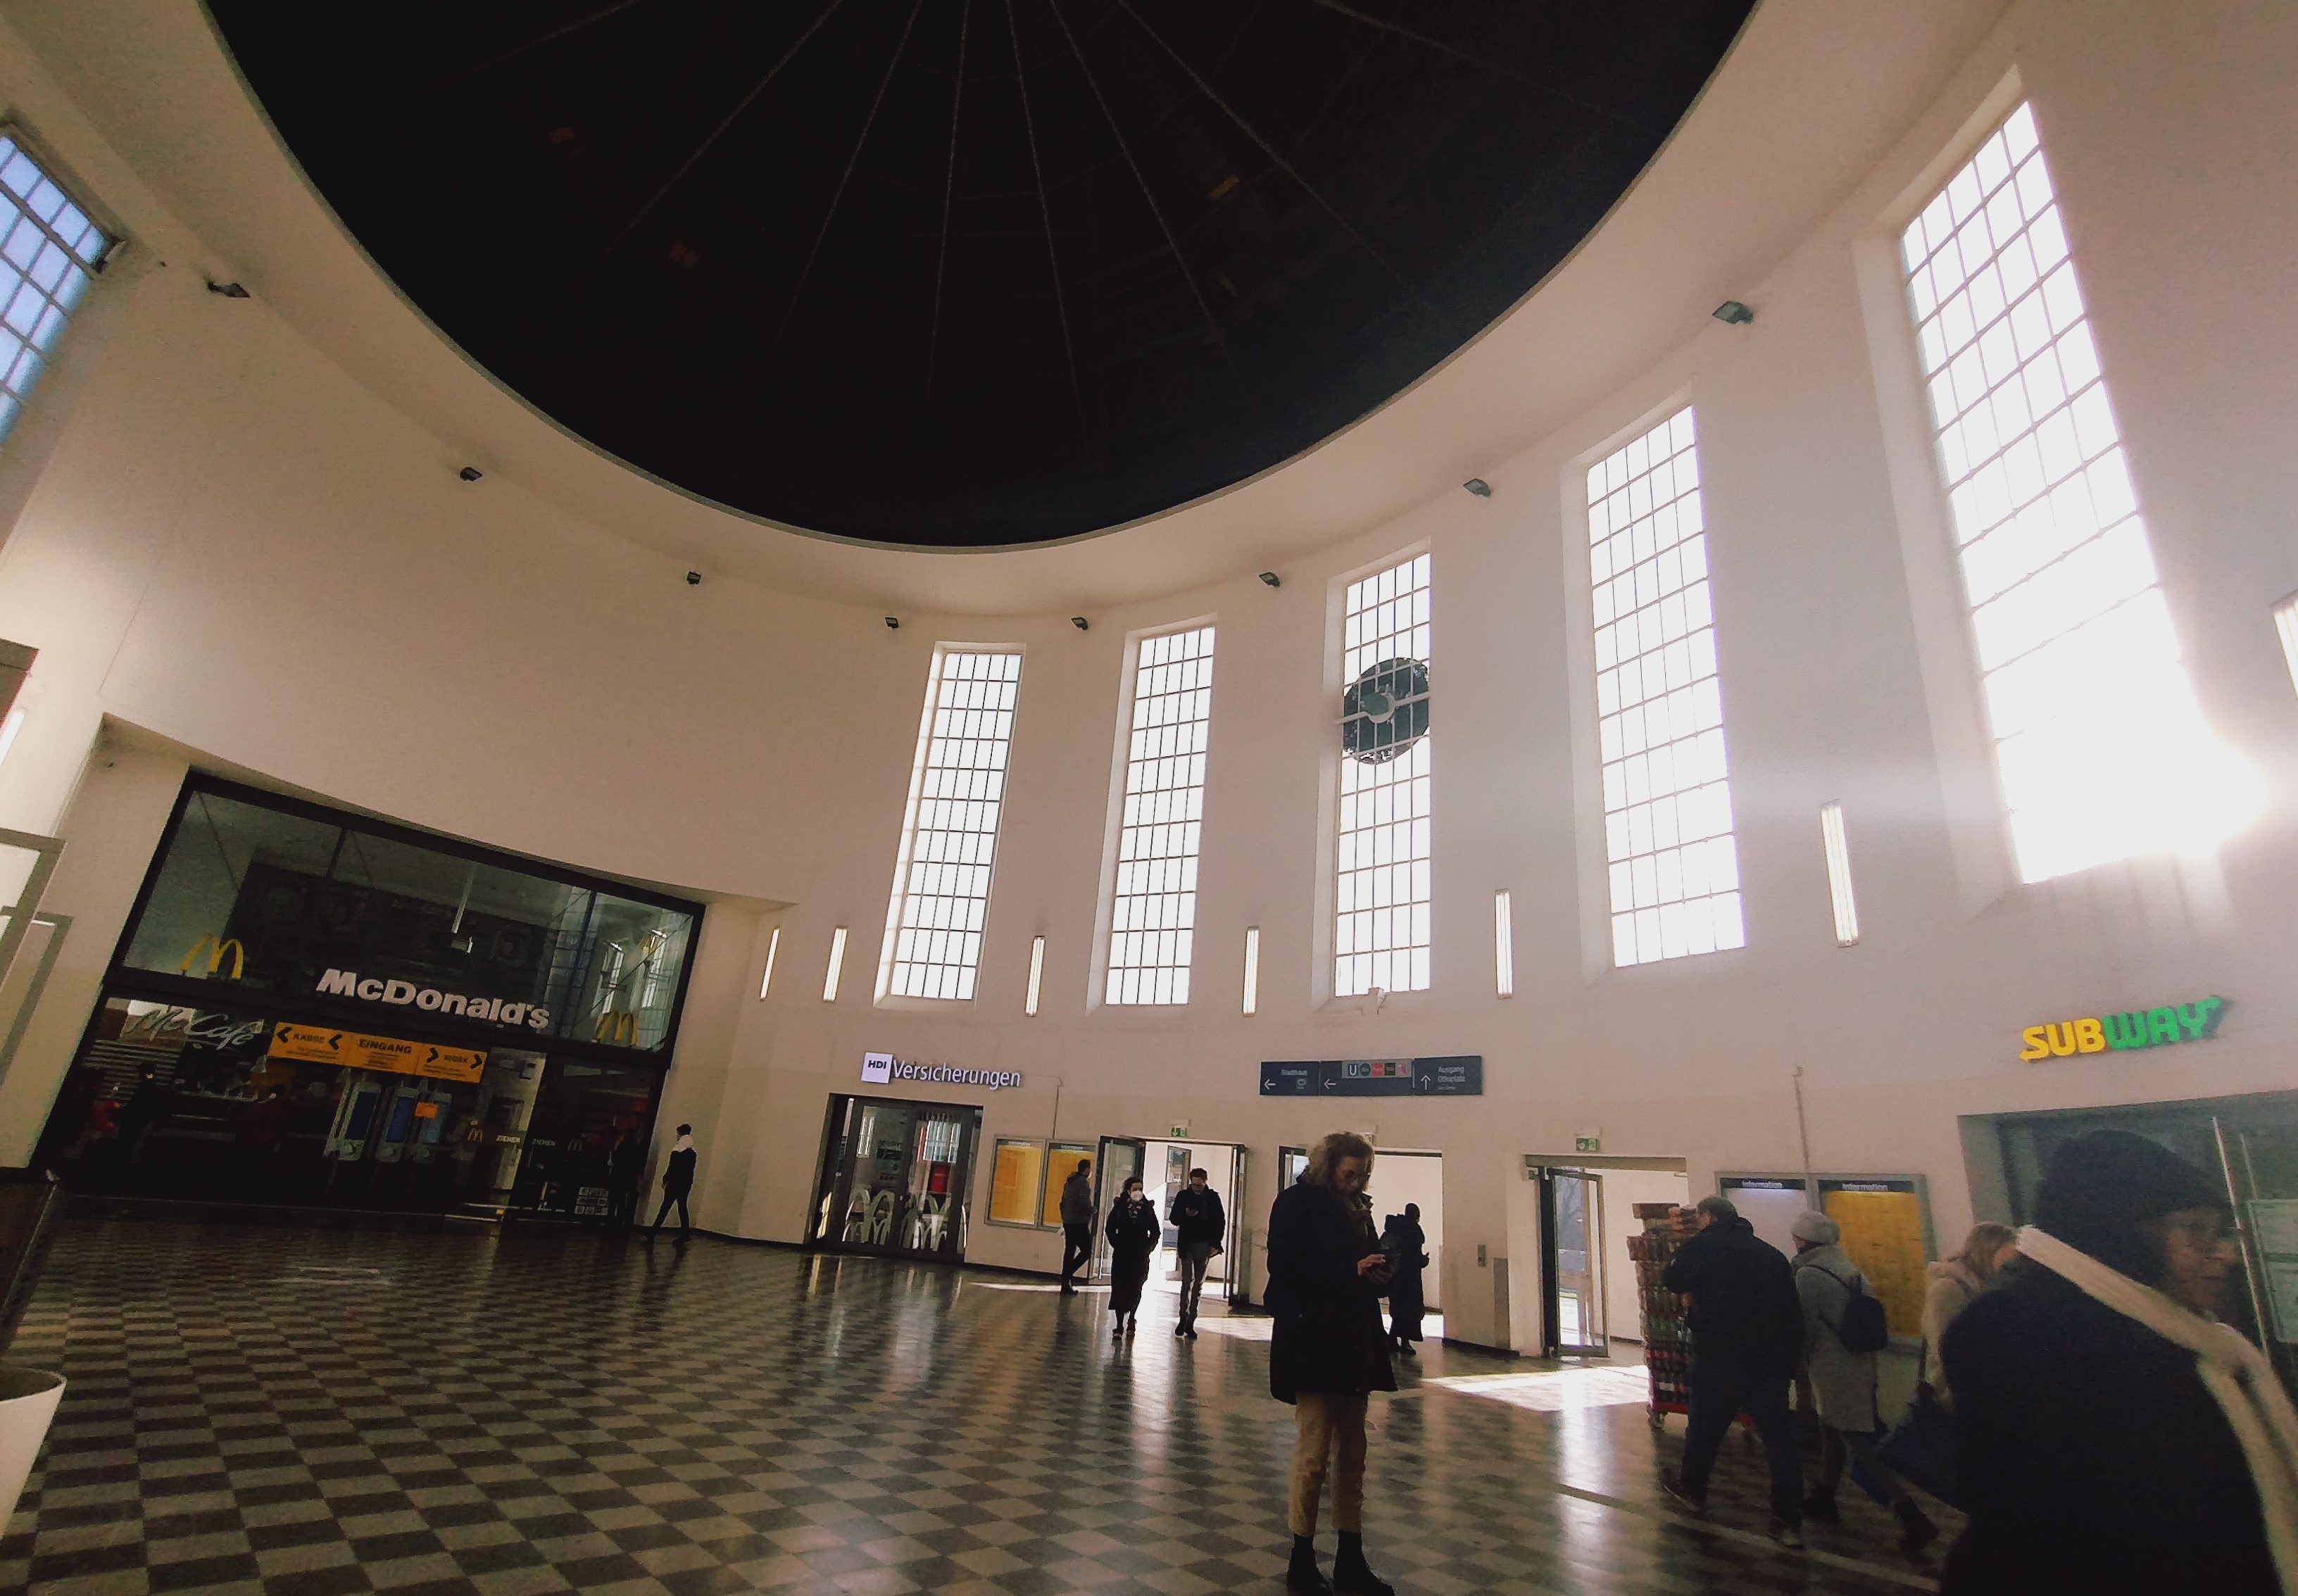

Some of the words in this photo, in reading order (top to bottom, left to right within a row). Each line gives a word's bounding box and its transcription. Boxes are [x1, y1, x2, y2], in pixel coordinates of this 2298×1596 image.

[316, 968, 550, 1029] McDonald's
[2019, 993, 2222, 1062] SUBWAY
[359, 1039, 413, 1055] EINGANG
[867, 1060, 887, 1069] HDI
[893, 1059, 1021, 1090] Versicherungen
[1349, 1064, 1357, 1076] U
